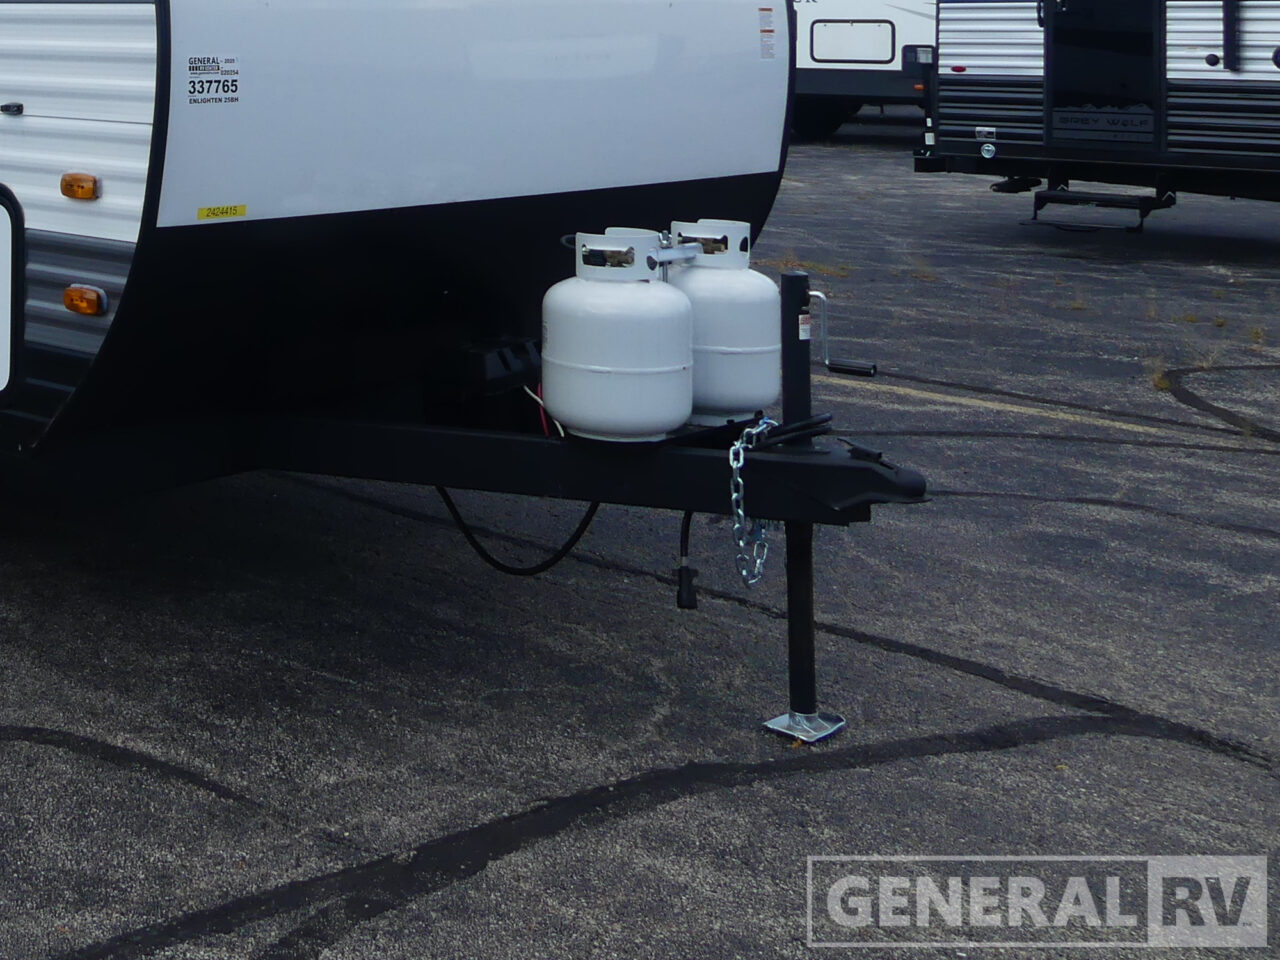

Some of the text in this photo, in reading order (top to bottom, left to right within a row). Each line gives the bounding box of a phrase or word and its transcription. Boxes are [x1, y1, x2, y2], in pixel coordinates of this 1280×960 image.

[188, 57, 220, 65] GENERAL
[188, 79, 238, 94] 337765
[189, 97, 222, 105] ENLIGHTEN
[206, 206, 238, 217] 2424415
